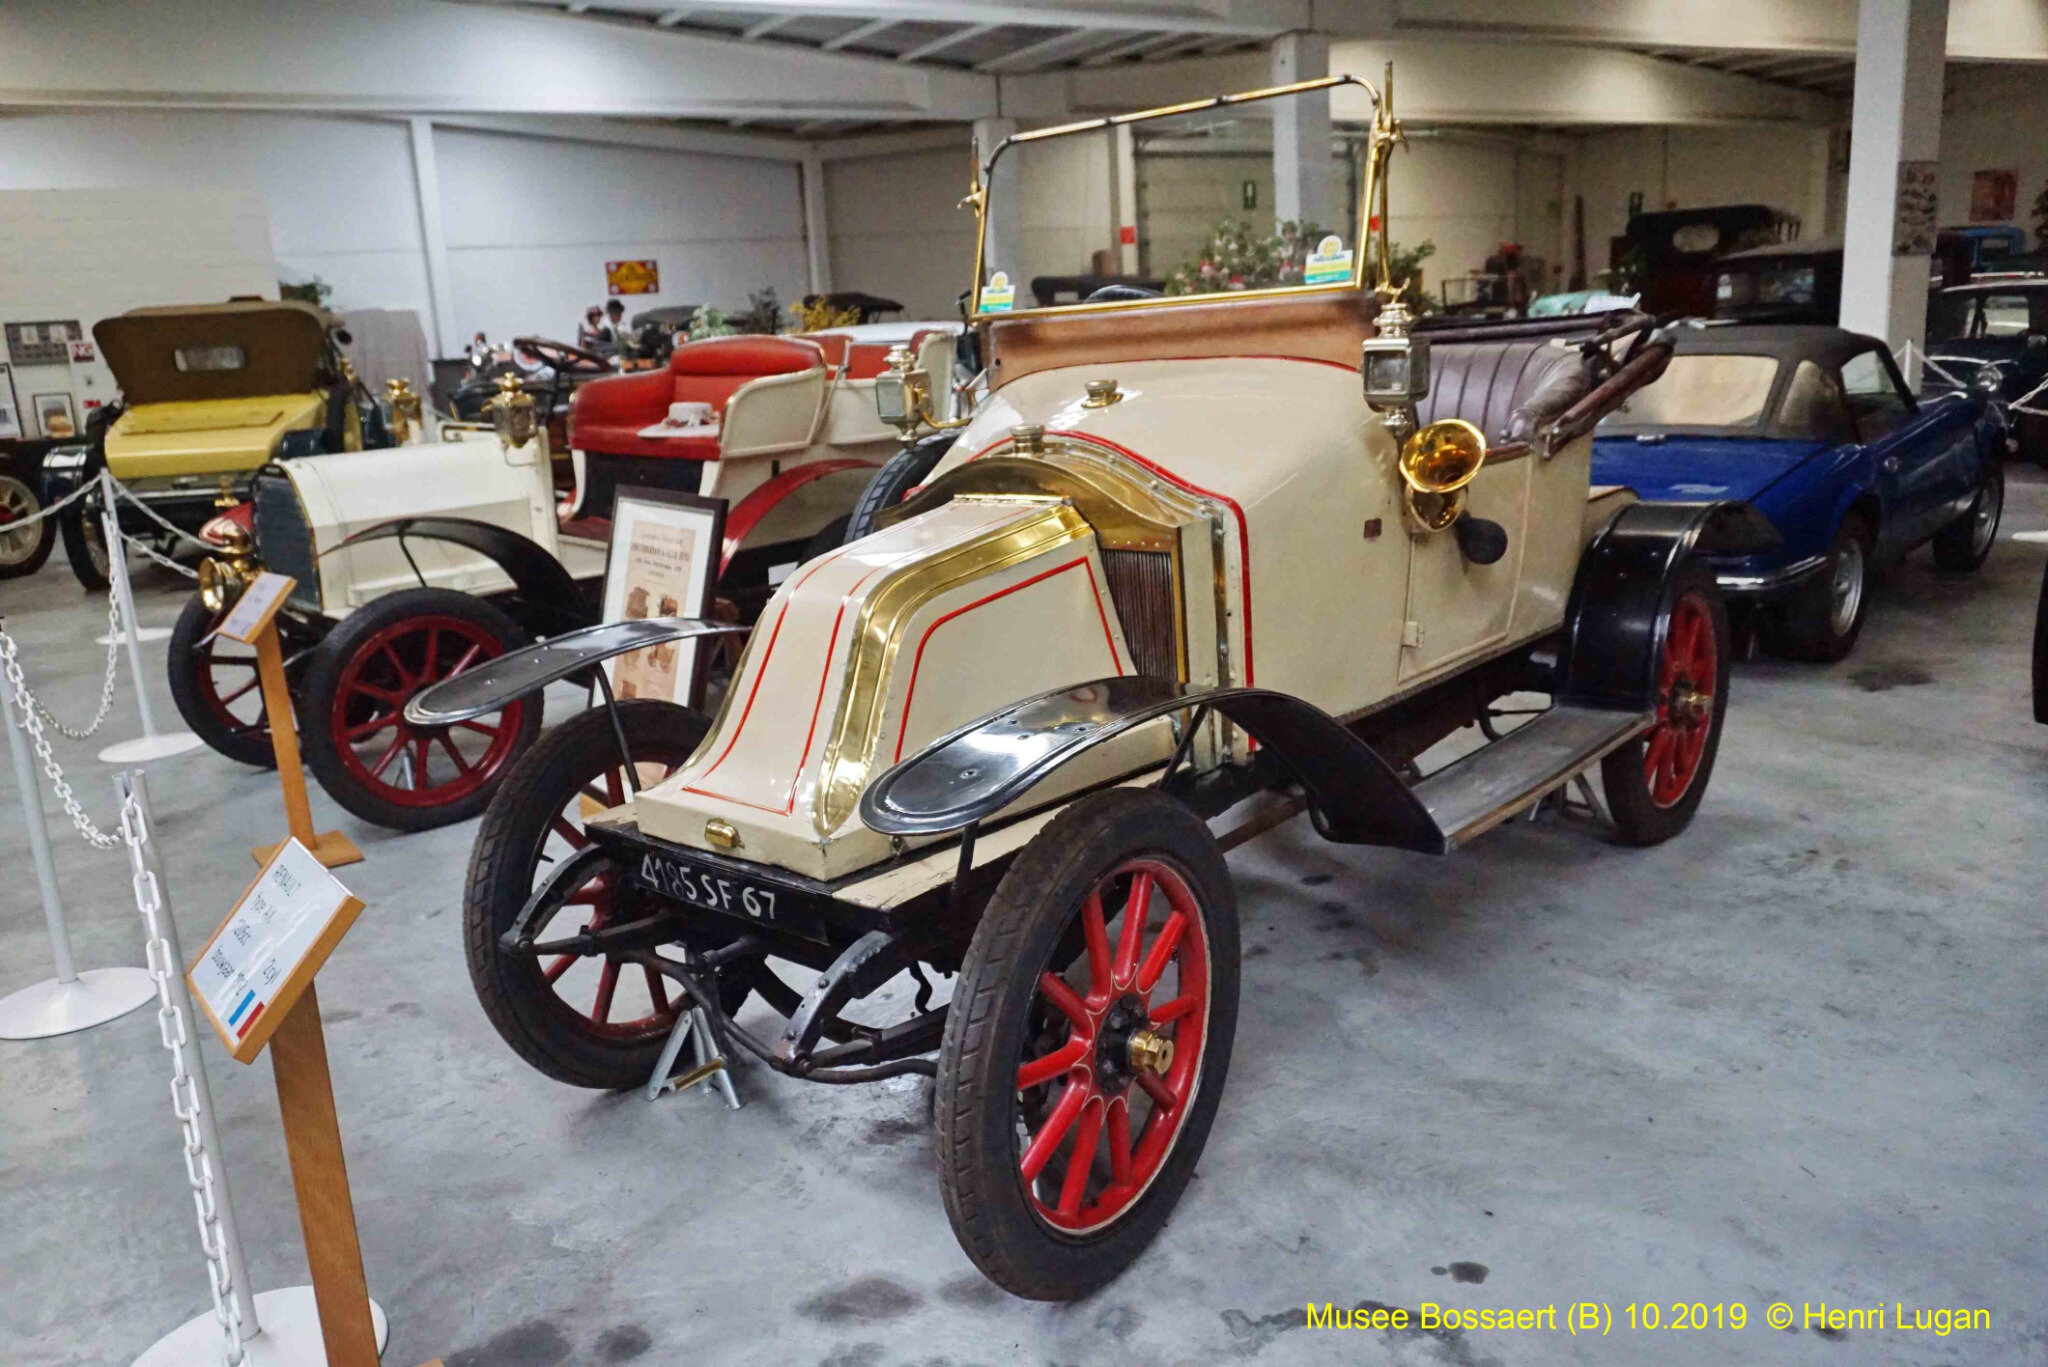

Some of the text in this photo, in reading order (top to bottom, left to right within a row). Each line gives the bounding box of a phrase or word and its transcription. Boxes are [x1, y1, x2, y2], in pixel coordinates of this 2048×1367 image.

[272, 865, 302, 896] RENAULT
[700, 874, 732, 910] SF
[742, 886, 775, 919] 67
